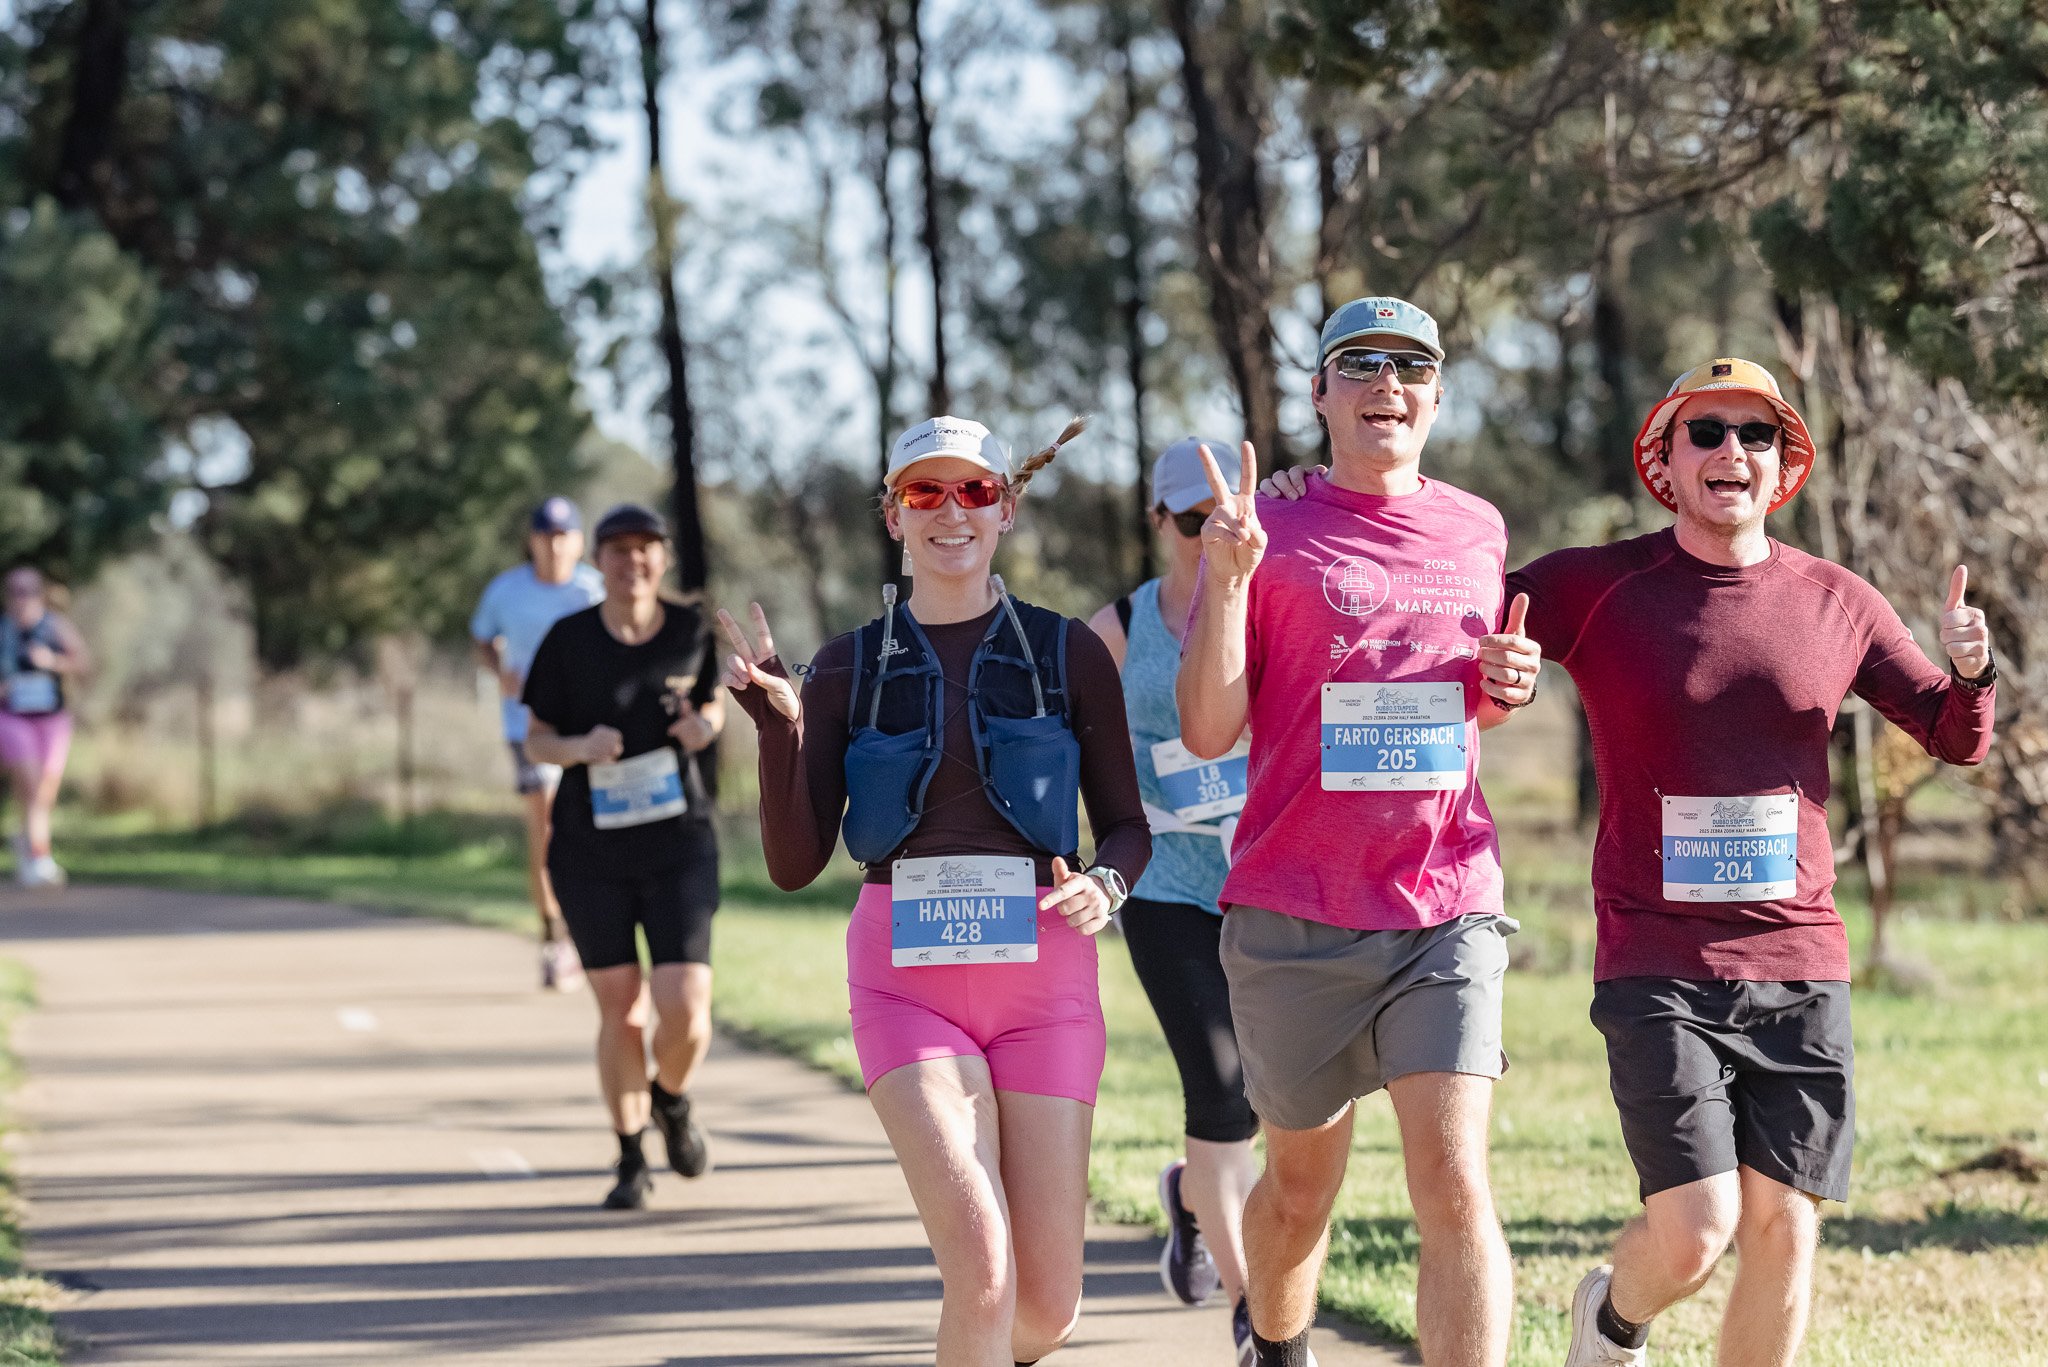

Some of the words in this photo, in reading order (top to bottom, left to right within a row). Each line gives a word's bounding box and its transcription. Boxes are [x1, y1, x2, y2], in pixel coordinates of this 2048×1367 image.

[1424, 559, 1457, 571] 2025
[1412, 588, 1471, 599] NEWCASTLE
[1395, 599, 1484, 619] MARATHON
[1334, 727, 1379, 746] FARTO
[1384, 726, 1455, 746] GERSBACH
[1376, 748, 1417, 770] 205
[1198, 764, 1221, 784] LB
[1197, 780, 1231, 803] 303
[1674, 840, 1720, 858] ROWAN
[1724, 838, 1788, 858] GERSBACH
[1713, 860, 1754, 882] 204
[919, 898, 1005, 922] HANNAH
[940, 922, 982, 944] 428
